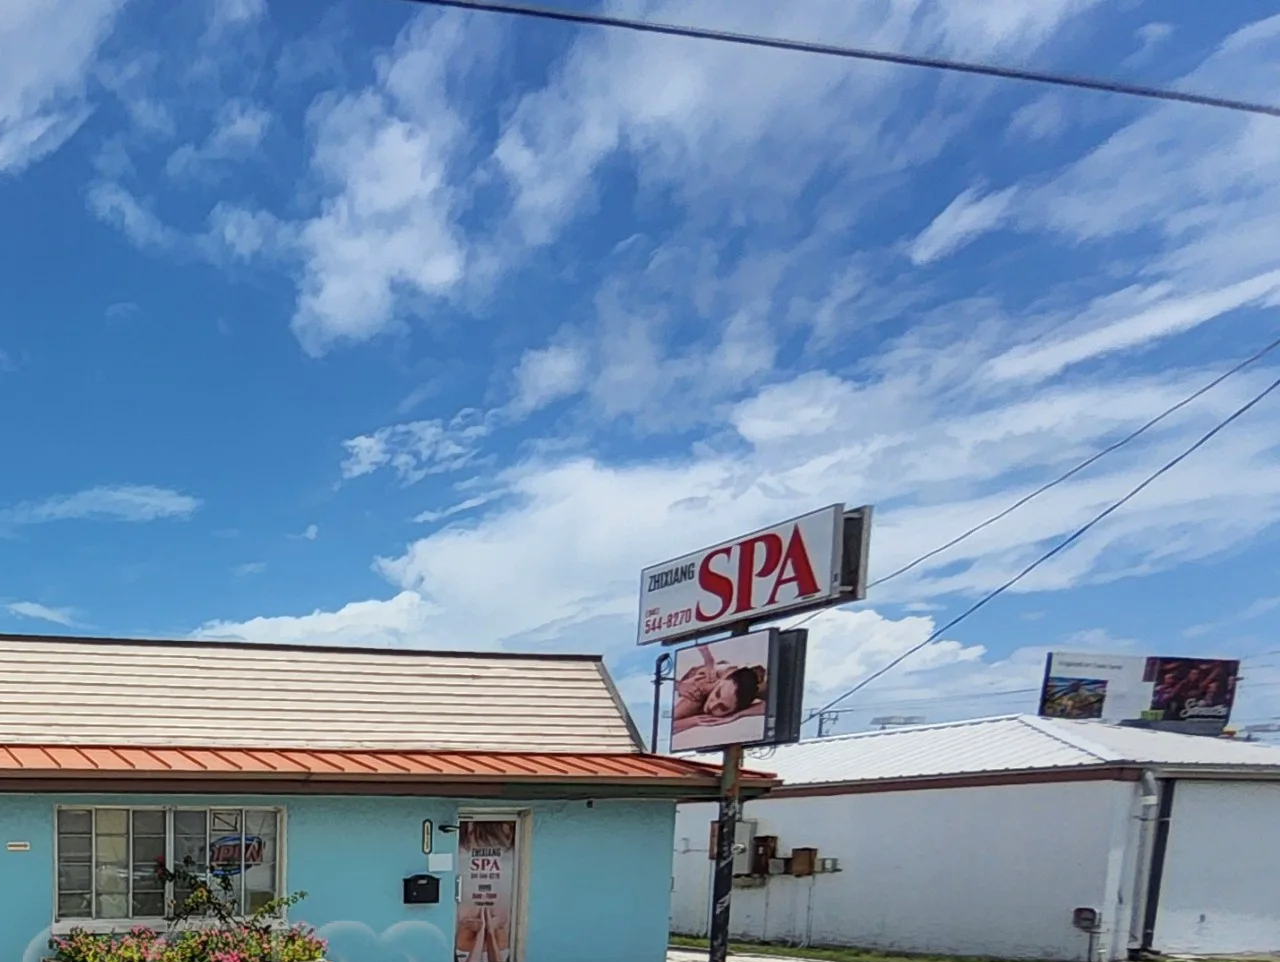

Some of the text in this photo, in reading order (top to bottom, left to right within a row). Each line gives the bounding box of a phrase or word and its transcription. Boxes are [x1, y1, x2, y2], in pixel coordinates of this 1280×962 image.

[648, 563, 695, 592] ZHIXIANG
[695, 524, 821, 622] SPA
[644, 608, 692, 634] 544-8270
[470, 858, 500, 871] SPA
